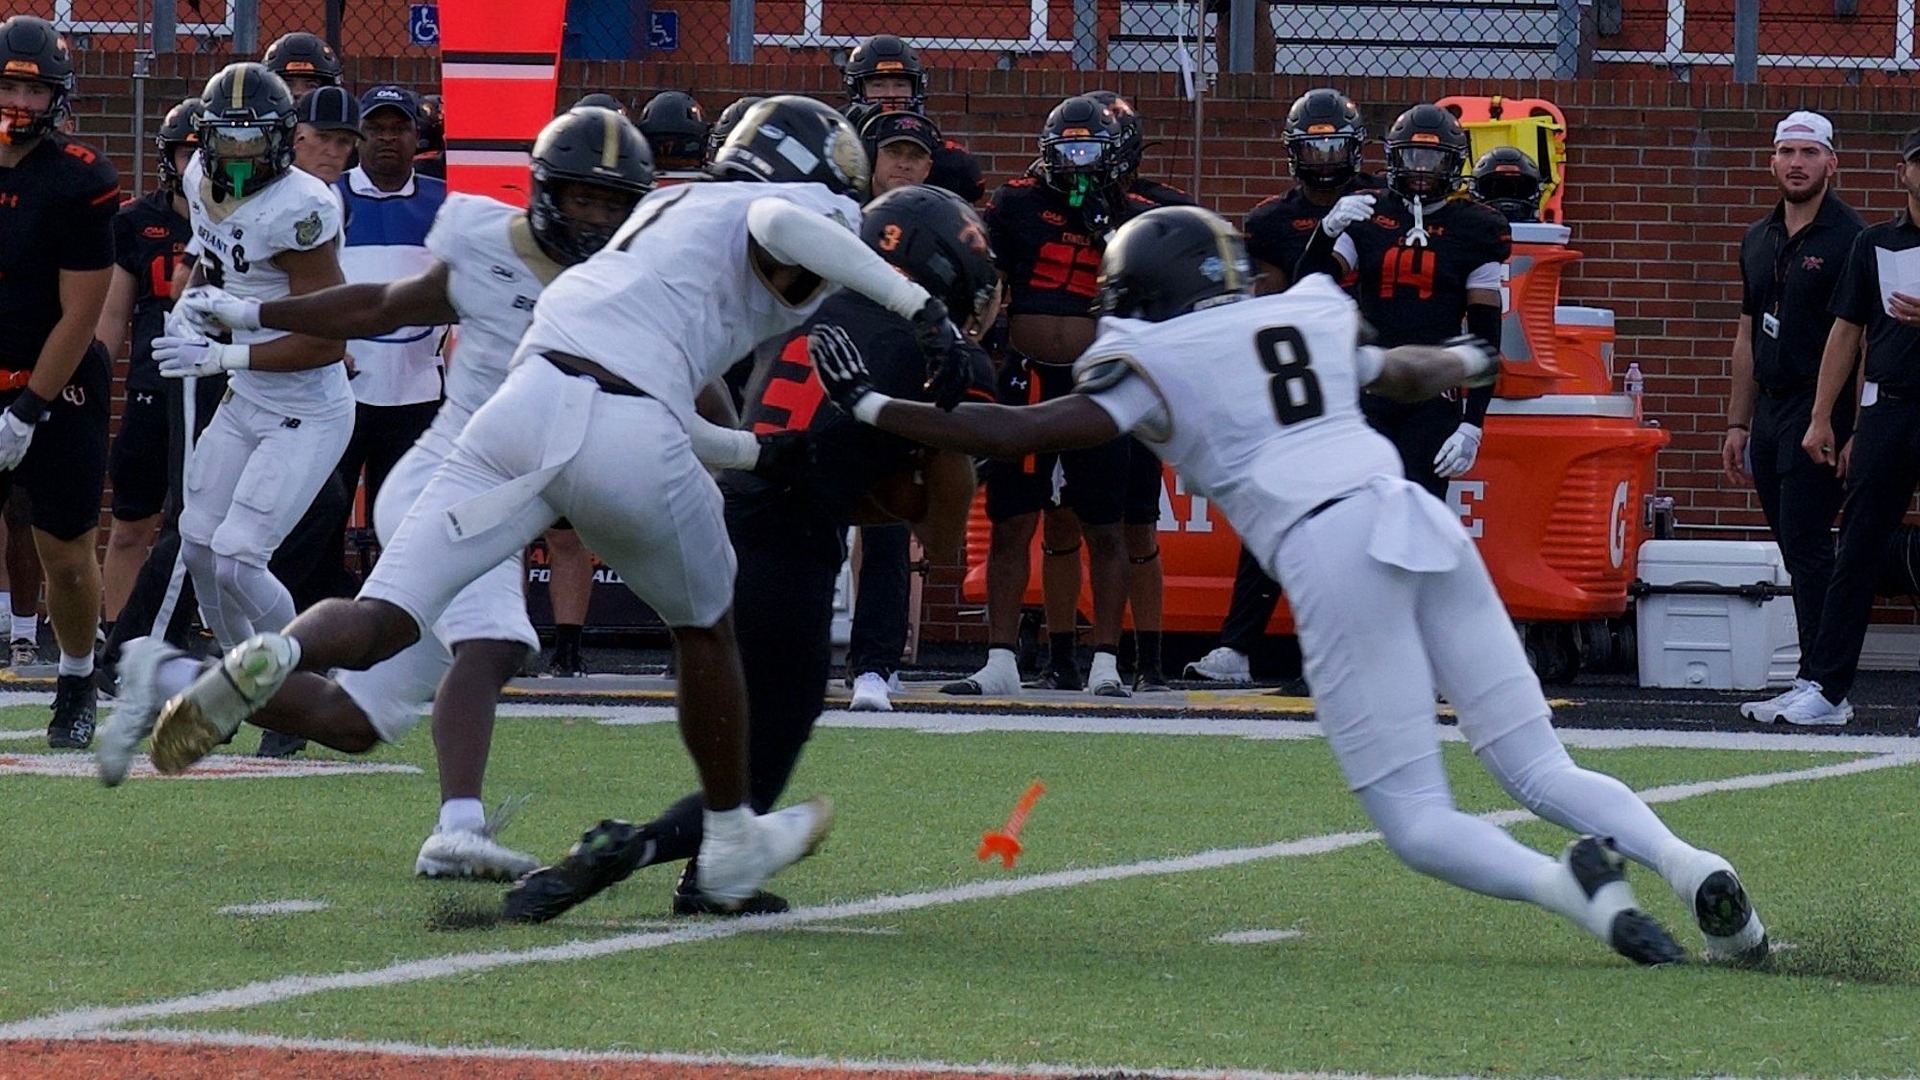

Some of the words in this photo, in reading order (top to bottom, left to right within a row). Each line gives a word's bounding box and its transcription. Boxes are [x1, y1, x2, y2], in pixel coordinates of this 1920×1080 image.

[879, 224, 902, 252] 3
[1380, 247, 1436, 299] 14
[1255, 325, 1325, 426] 8
[1609, 480, 1629, 569] G
